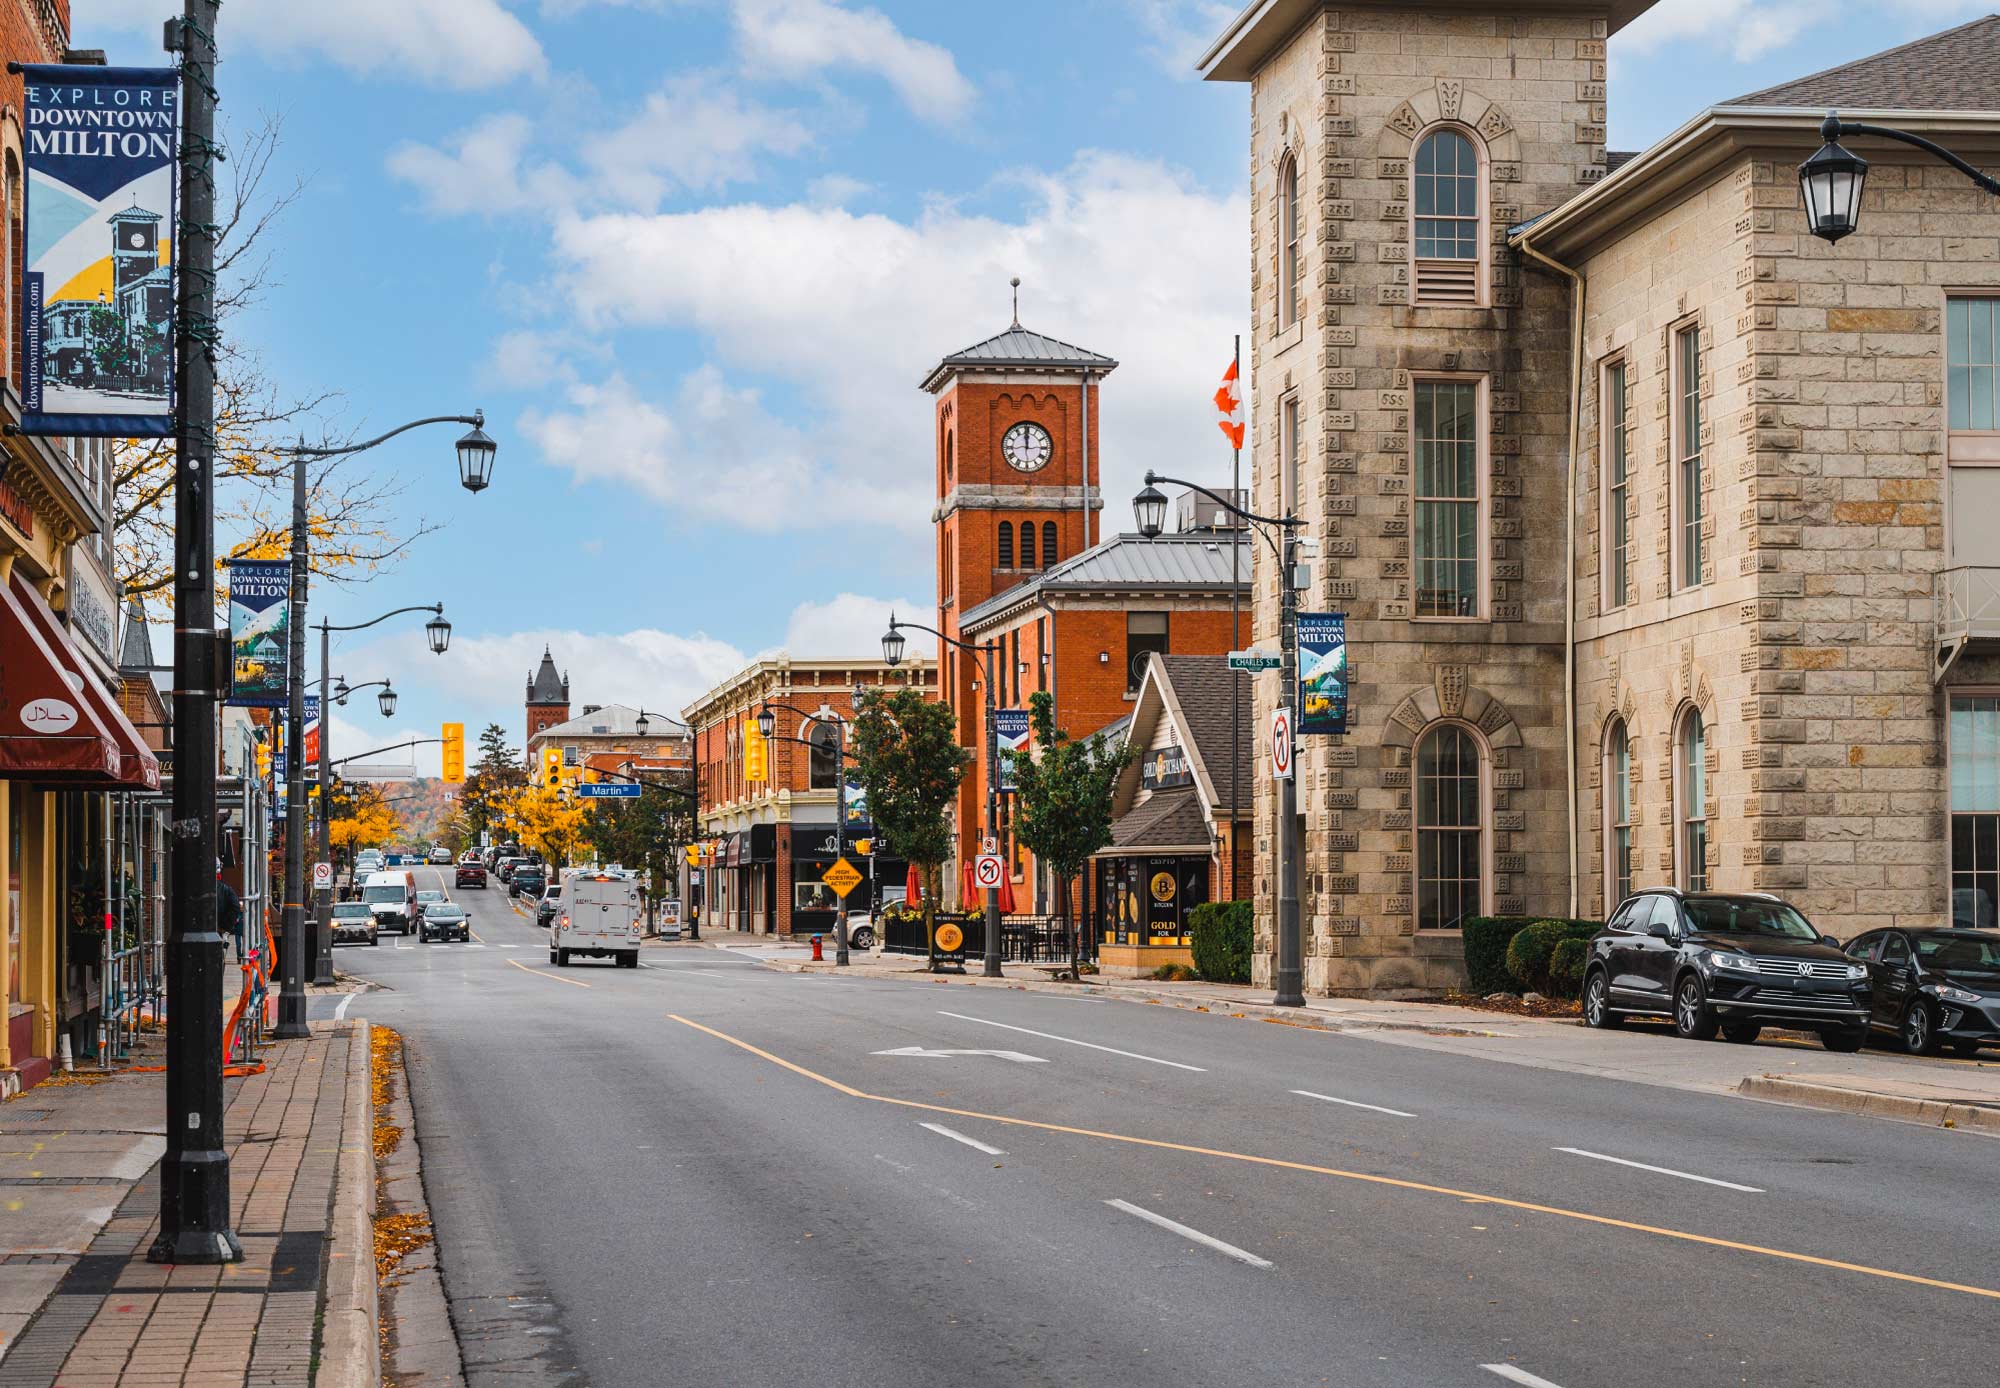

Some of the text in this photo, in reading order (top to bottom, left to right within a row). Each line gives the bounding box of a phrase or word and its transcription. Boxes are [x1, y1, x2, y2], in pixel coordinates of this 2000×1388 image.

[30, 87, 174, 106] EXPLORE
[29, 108, 173, 128] DOWNTOWN
[29, 129, 173, 158] MILTON
[27, 282, 39, 409] downtownmilton.com
[231, 567, 289, 576] EXPLORE
[231, 576, 288, 584] DOWNTOWN
[231, 585, 288, 597] MILTON
[1298, 618, 1344, 626] EXPLORE
[1299, 633, 1345, 643] MILTON
[1235, 658, 1264, 667] CHARLES
[592, 786, 622, 795] Martin
[1151, 921, 1176, 930] GOLD
